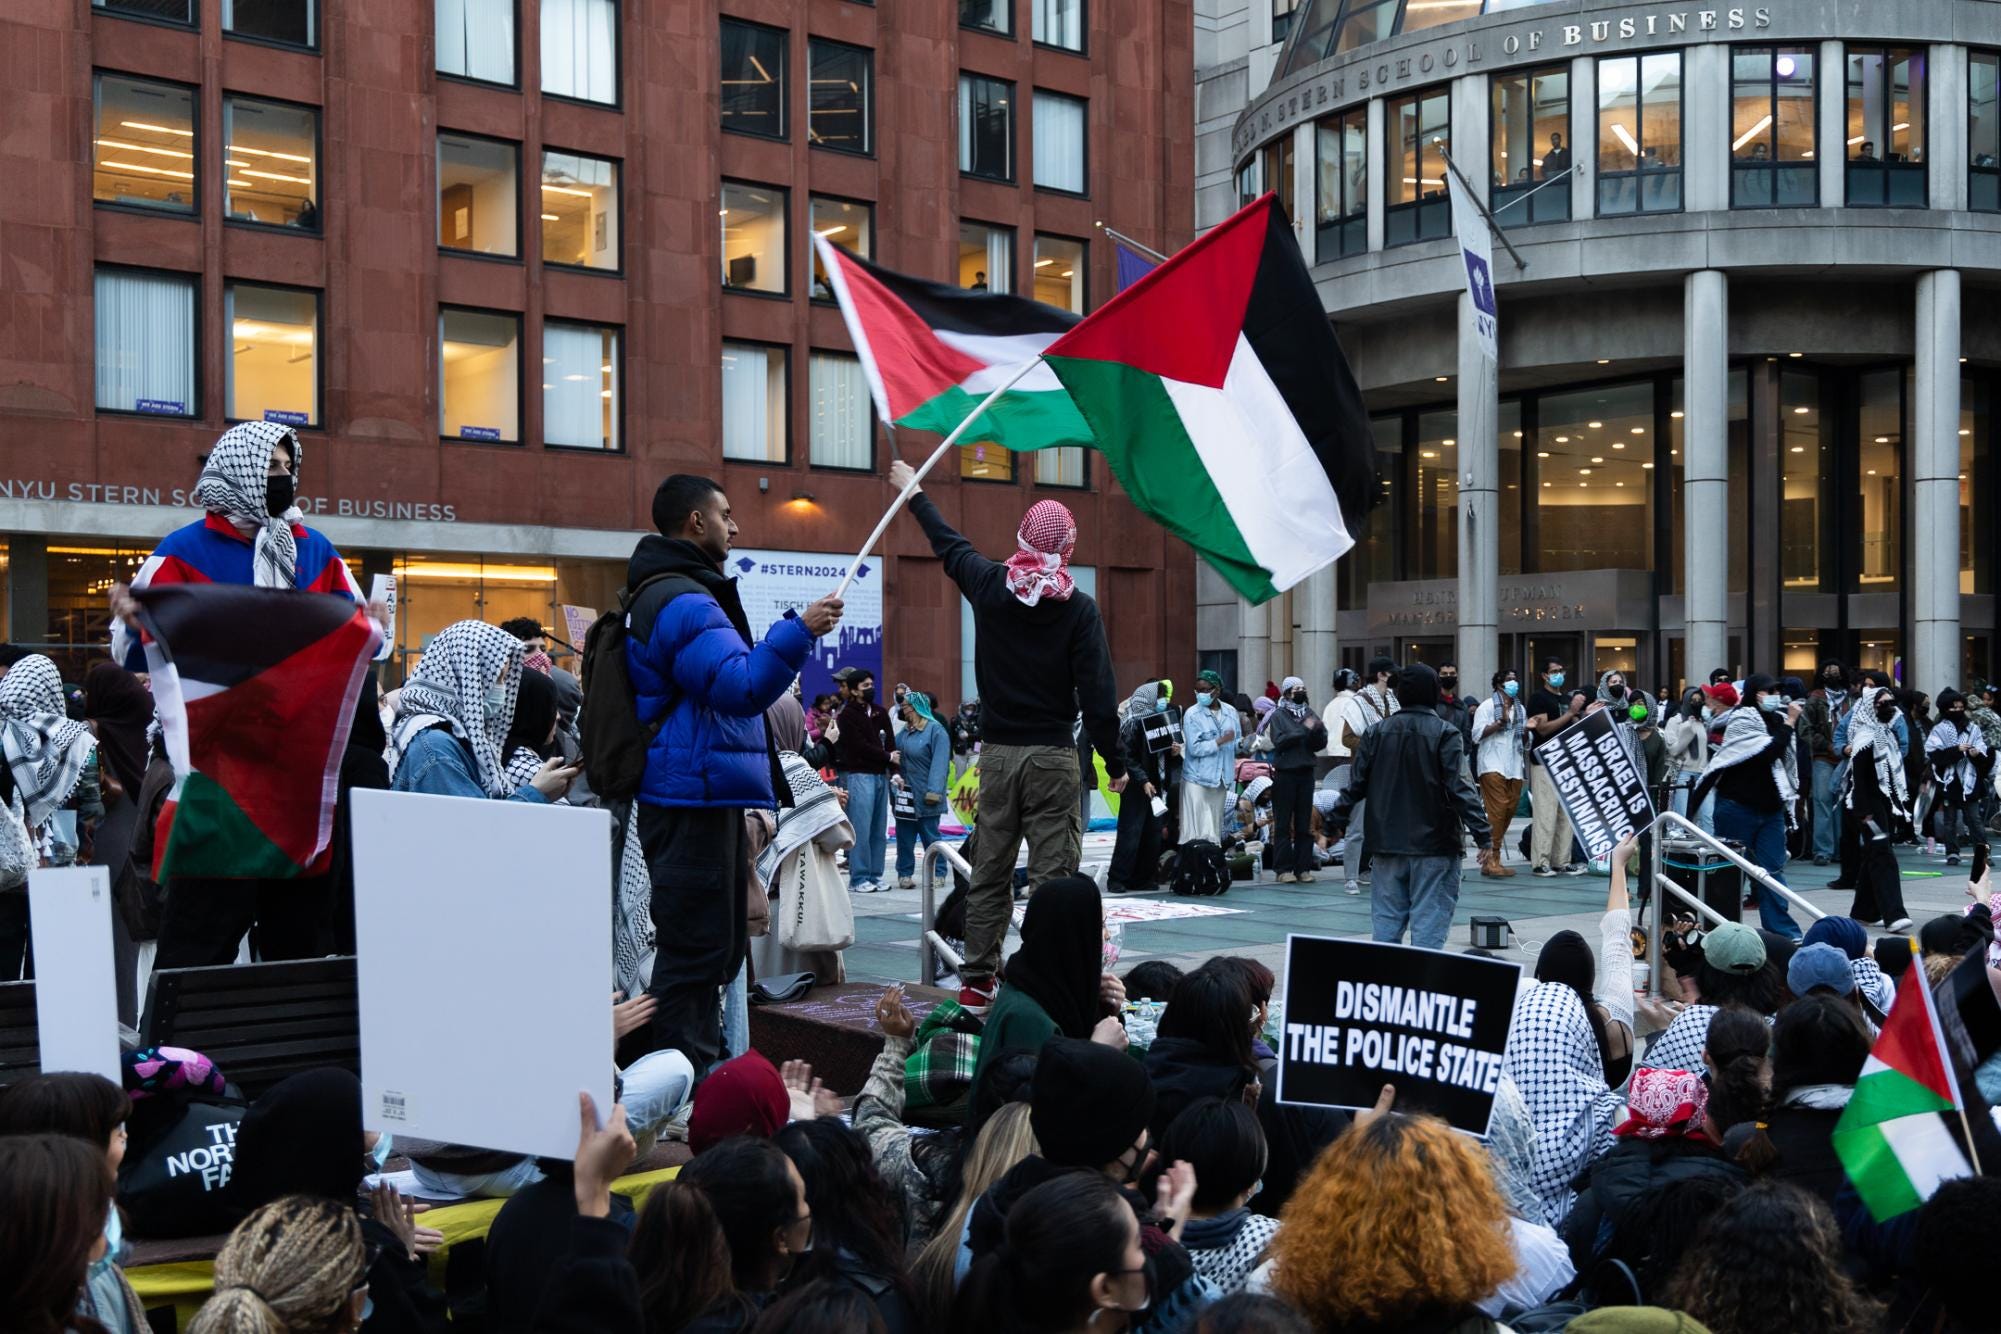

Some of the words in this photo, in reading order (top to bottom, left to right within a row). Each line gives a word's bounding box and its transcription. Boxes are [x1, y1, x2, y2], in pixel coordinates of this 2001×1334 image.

[1278, 78, 1345, 123] STERN
[1358, 43, 1482, 90] SCHOOL
[1502, 30, 1544, 55] OF
[1562, 8, 1772, 46] BUSINESS
[0, 479, 56, 500] NYU
[68, 482, 161, 505] STERN
[293, 495, 329, 514] OF
[338, 499, 456, 522] BUSINESS
[760, 563, 846, 578] #STERN2024
[565, 606, 579, 618] NO
[774, 600, 804, 610] TISCH
[1413, 590, 1458, 605] HENR
[1564, 730, 1635, 842] MASSACRING
[1594, 731, 1637, 796] ISRAEL
[1626, 791, 1647, 815] IS
[1539, 738, 1613, 856] PALESTINIANS
[796, 851, 806, 927] TAWAKKUL
[1335, 980, 1477, 1039] DISMANTLE
[1287, 1022, 1340, 1065] THE
[1345, 1027, 1436, 1078] POLICE
[1436, 1042, 1503, 1094] STATE
[205, 1120, 241, 1144] TH
[166, 1143, 237, 1178] NOR
[201, 1163, 232, 1192] FA
